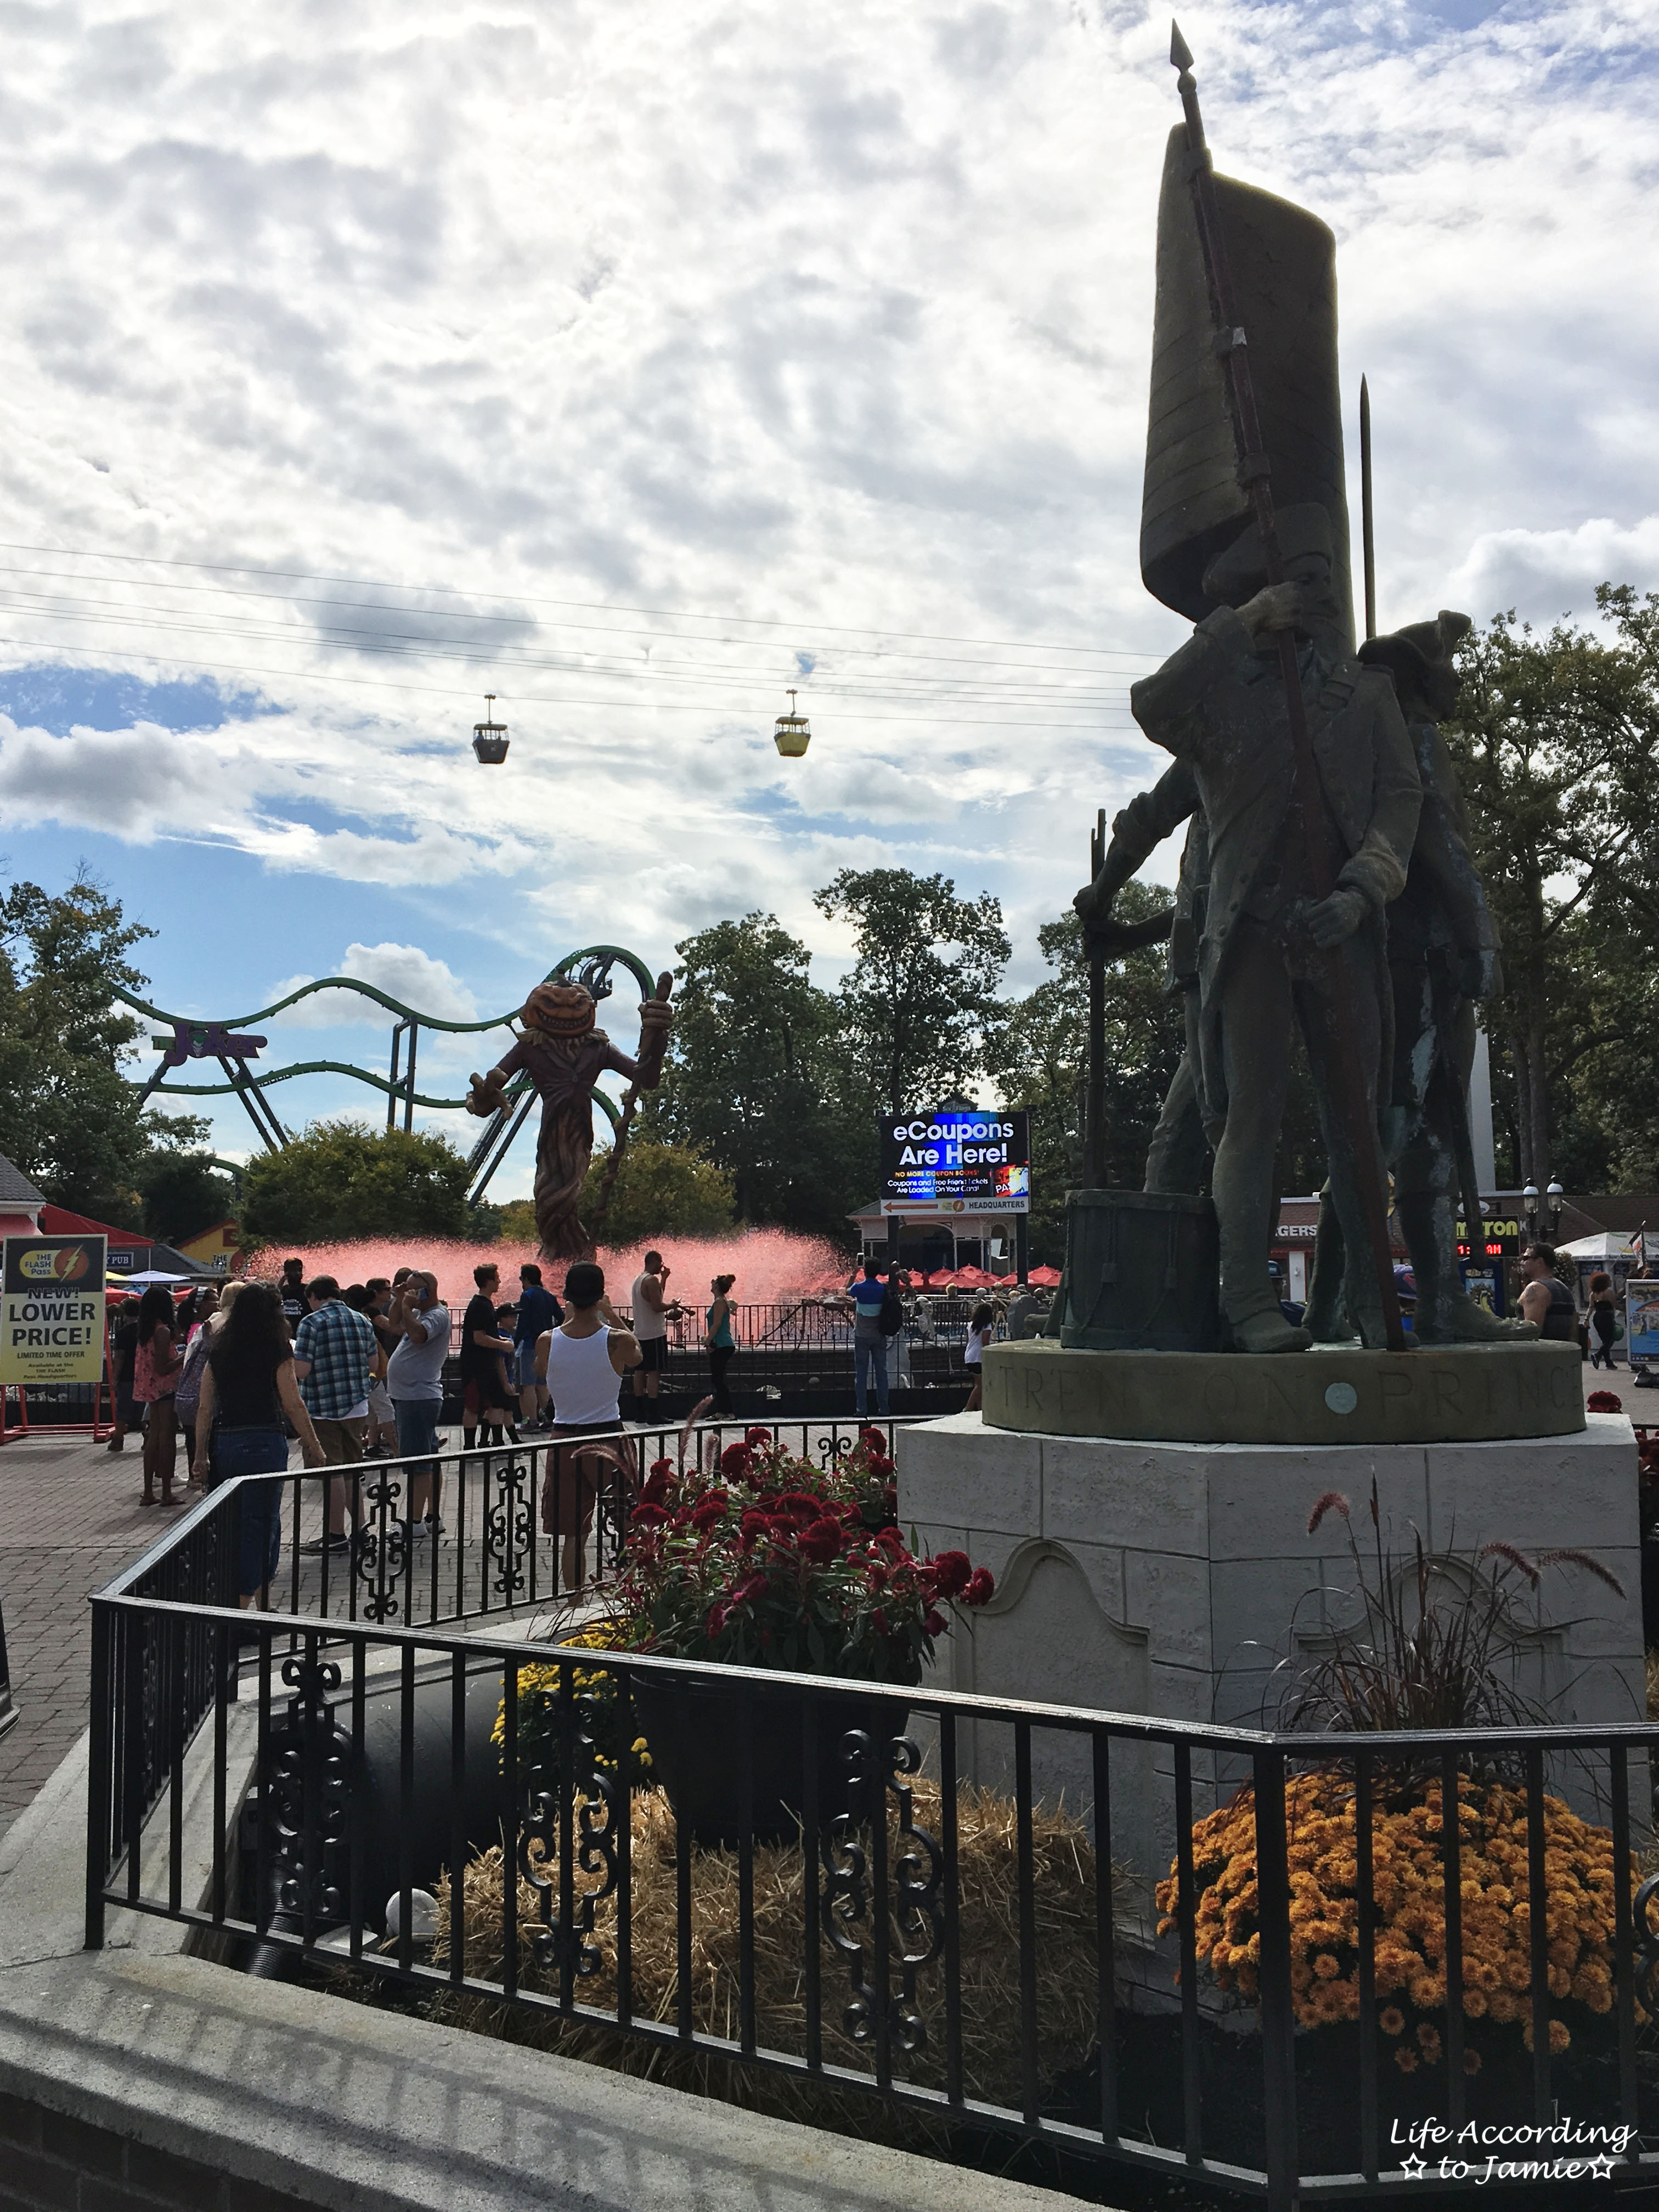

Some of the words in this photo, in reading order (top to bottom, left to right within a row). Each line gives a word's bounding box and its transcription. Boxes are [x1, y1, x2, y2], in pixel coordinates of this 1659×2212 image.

[893, 1121, 1014, 1143] eCoupons
[899, 1146, 939, 1165] Are
[946, 1143, 1007, 1164] Here!
[1275, 1224, 1317, 1237] GERS
[1486, 1244, 1501, 1254] AM
[28, 1287, 80, 1299] NEW!
[9, 1303, 95, 1322] LOWER
[12, 1327, 91, 1346] PRICE!
[1000, 1366, 1306, 1419] TRENTON
